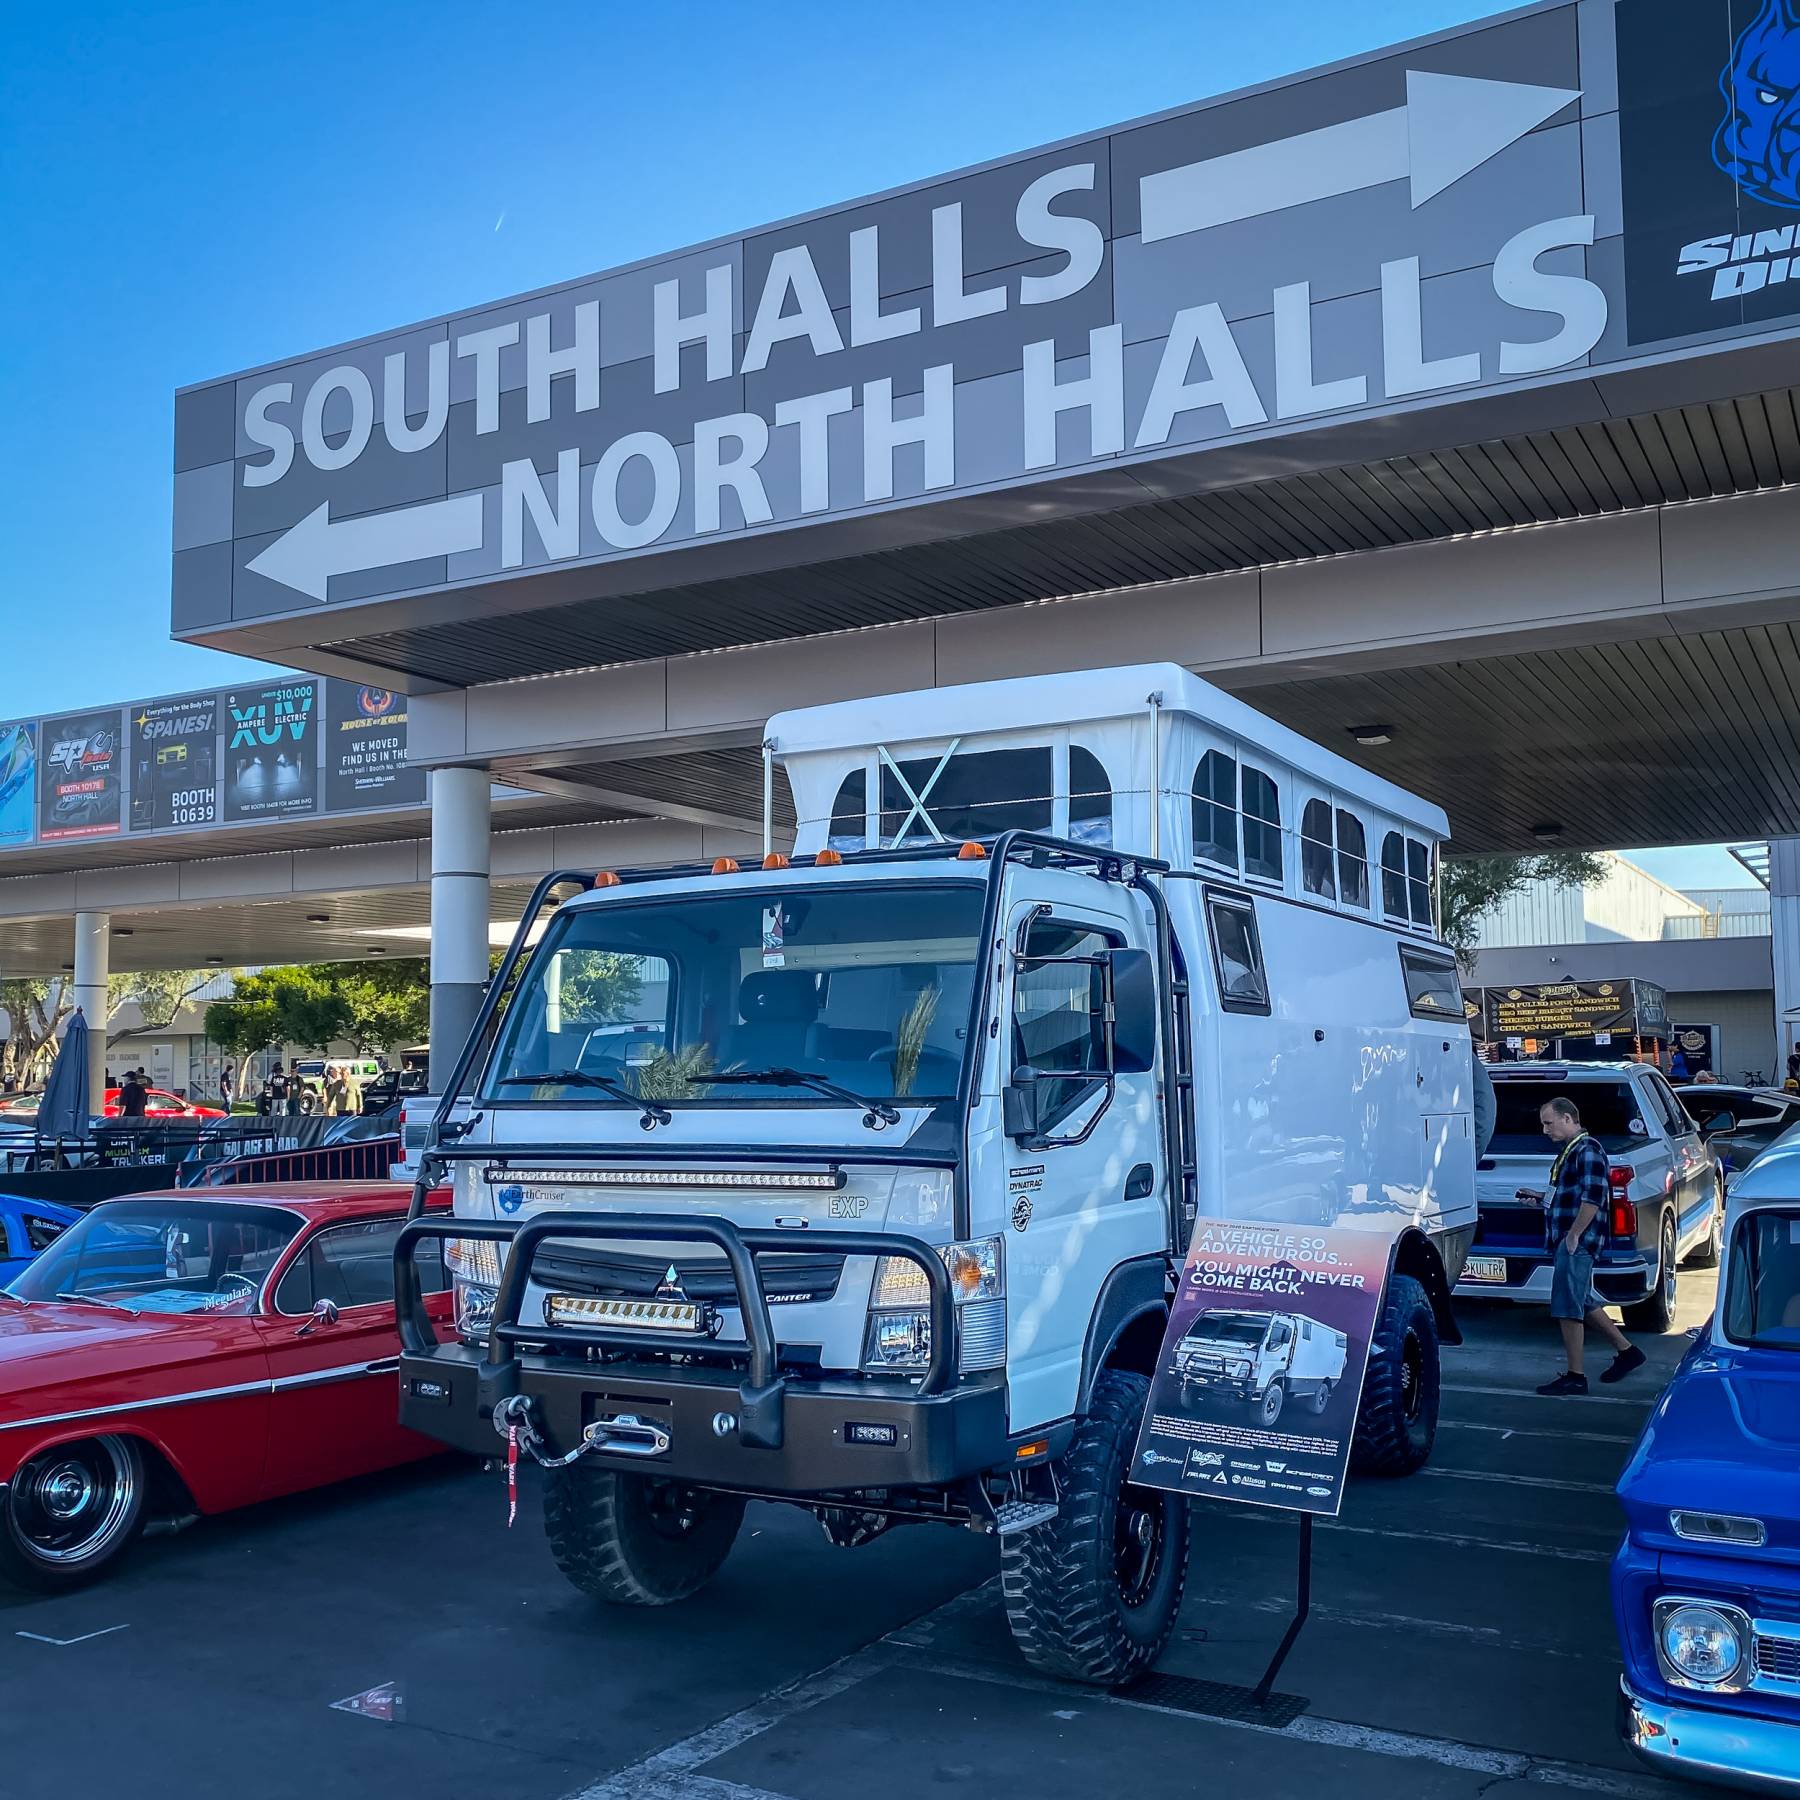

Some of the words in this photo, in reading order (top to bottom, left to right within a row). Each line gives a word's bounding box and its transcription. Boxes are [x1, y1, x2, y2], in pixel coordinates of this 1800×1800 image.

[1676, 224, 1800, 275] SIN
[1711, 255, 1800, 301] DI
[244, 301, 600, 488] SOUTH
[654, 163, 1104, 394] HALLS
[501, 363, 955, 569] NORTH
[1023, 215, 1608, 470] HALLS
[276, 686, 312, 700] $10,000
[146, 706, 173, 716] Everything
[190, 701, 202, 709] Body
[143, 713, 213, 740] SPANESI
[230, 698, 312, 748] XUV
[237, 718, 266, 729] AMPERE
[275, 713, 307, 724] ELECTRIC
[352, 741, 365, 752] WE
[368, 737, 398, 750] MOVED
[342, 754, 362, 766] FIND
[365, 752, 376, 763] US
[380, 750, 389, 761] IN
[392, 748, 408, 760] THE
[60, 784, 80, 794] BOOTH
[63, 795, 83, 803] NORTH
[84, 792, 98, 800] HALL
[172, 788, 214, 807] BOOTH
[172, 806, 214, 824] 10639
[1573, 997, 1620, 1006] SANDWICH
[1574, 1004, 1620, 1013] SANDWICH
[1500, 1024, 1539, 1032] CHICKEN
[1541, 1022, 1591, 1031] SANDWICH
[1009, 1179, 1043, 1191] DYNATRAC
[828, 1196, 869, 1218] EXP
[1202, 1229, 1214, 1240] A
[1221, 1230, 1294, 1248] VEHICLE
[1301, 1237, 1326, 1250] SO
[1198, 1240, 1353, 1267] ADVENTUROUS...
[1194, 1259, 1232, 1274] YOU
[1235, 1263, 1297, 1281] MIGHT
[1301, 1270, 1365, 1288] NEVER
[1190, 1272, 1245, 1289] COME
[1249, 1277, 1305, 1296] BACK.
[204, 1285, 252, 1311] Meguiar's
[765, 1293, 811, 1303] CANTER
